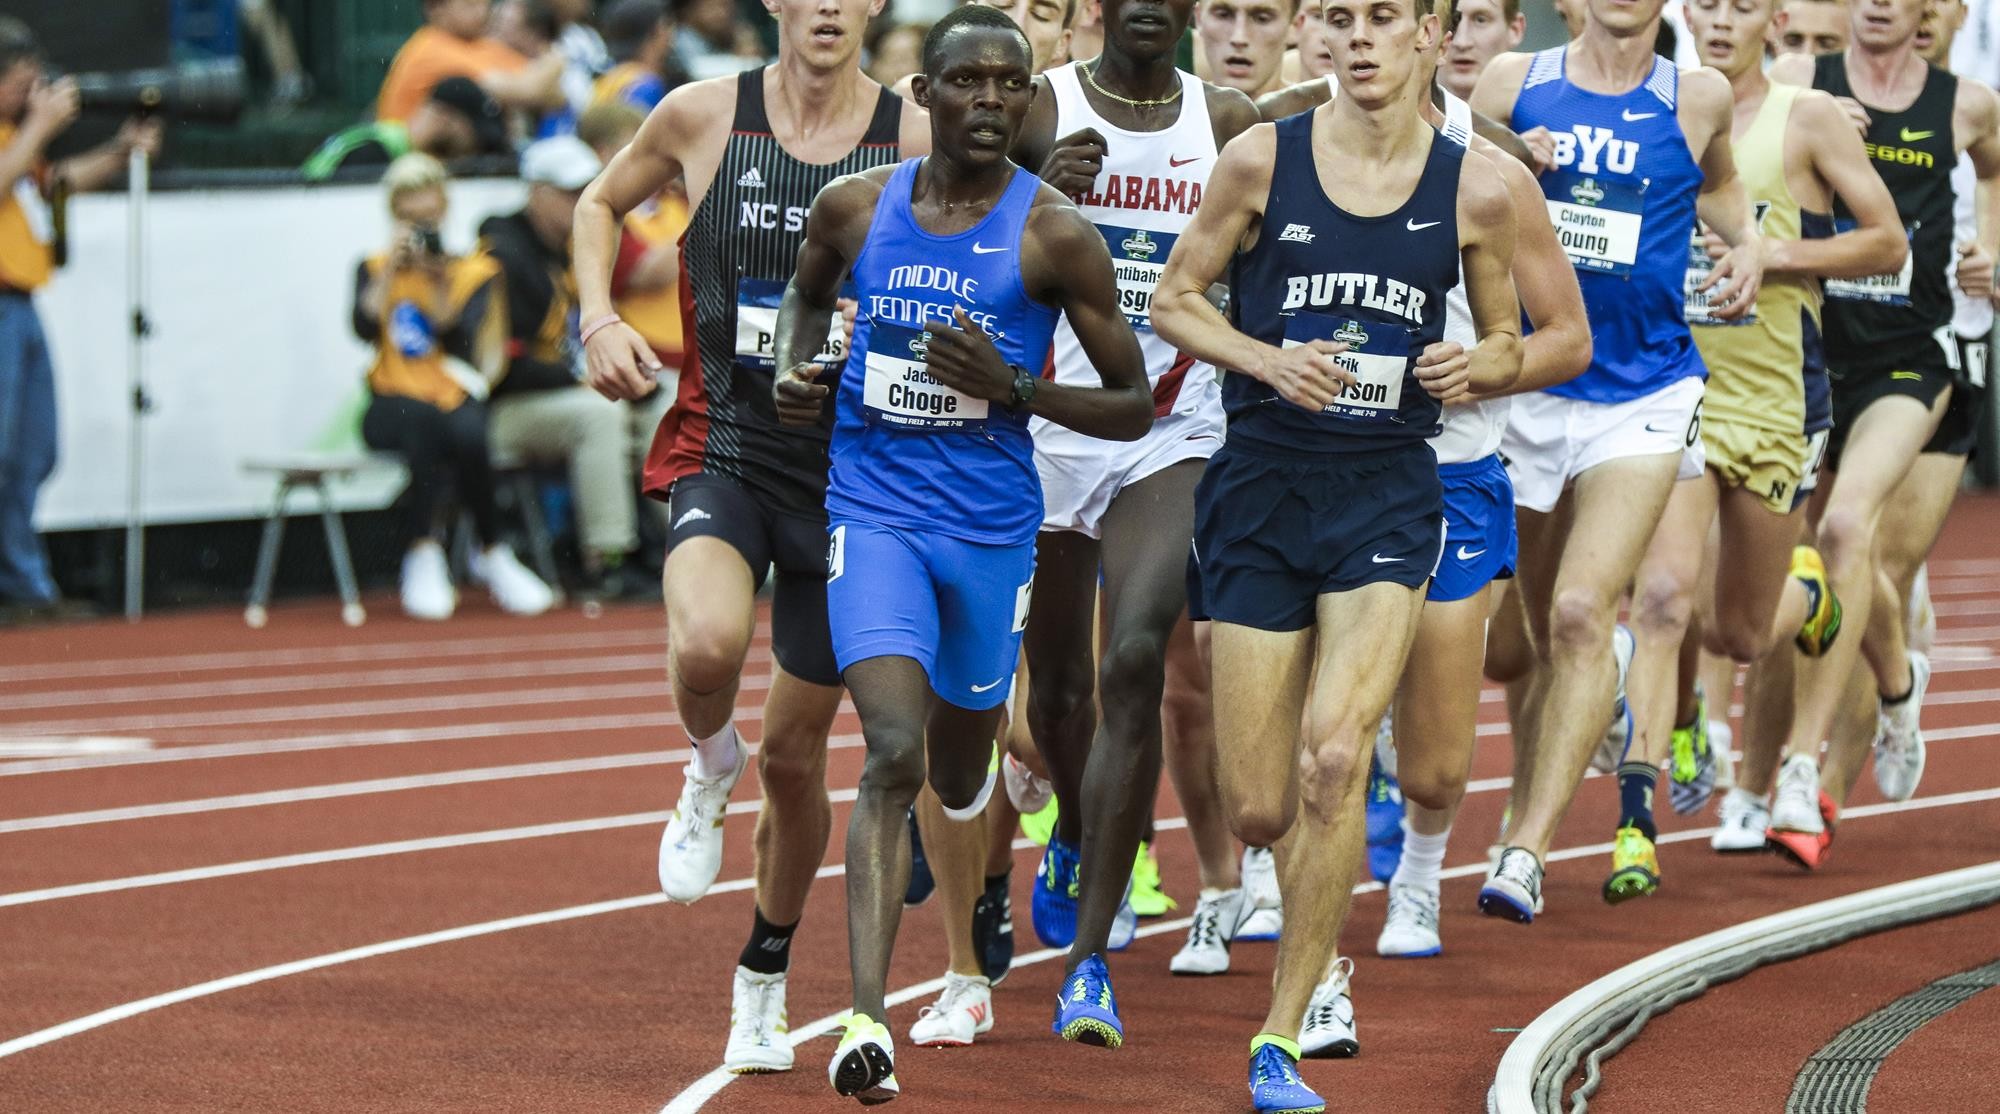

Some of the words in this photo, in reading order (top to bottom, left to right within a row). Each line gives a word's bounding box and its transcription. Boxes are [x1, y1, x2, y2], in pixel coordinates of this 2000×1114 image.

[1549, 124, 1640, 174] BYU
[1865, 143, 1934, 169] EGON
[738, 179, 766, 188] adidas
[1071, 174, 1202, 215] LABAMA
[741, 202, 777, 229] NC
[785, 206, 810, 232] S
[1285, 223, 1311, 232] BIG
[1561, 208, 1606, 228] Clayton
[1280, 231, 1316, 242] EAST
[1553, 224, 1609, 255] Young
[888, 265, 979, 304] MIDDLE
[1116, 266, 1162, 283] ntibahs
[1282, 272, 1426, 325] BUTLER
[889, 383, 957, 415] Choge
[1340, 381, 1388, 403] rson
[881, 413, 908, 424] HAYWARD
[908, 418, 925, 426] FIELD
[1349, 408, 1365, 416] JUNE
[1769, 480, 1787, 499] N
